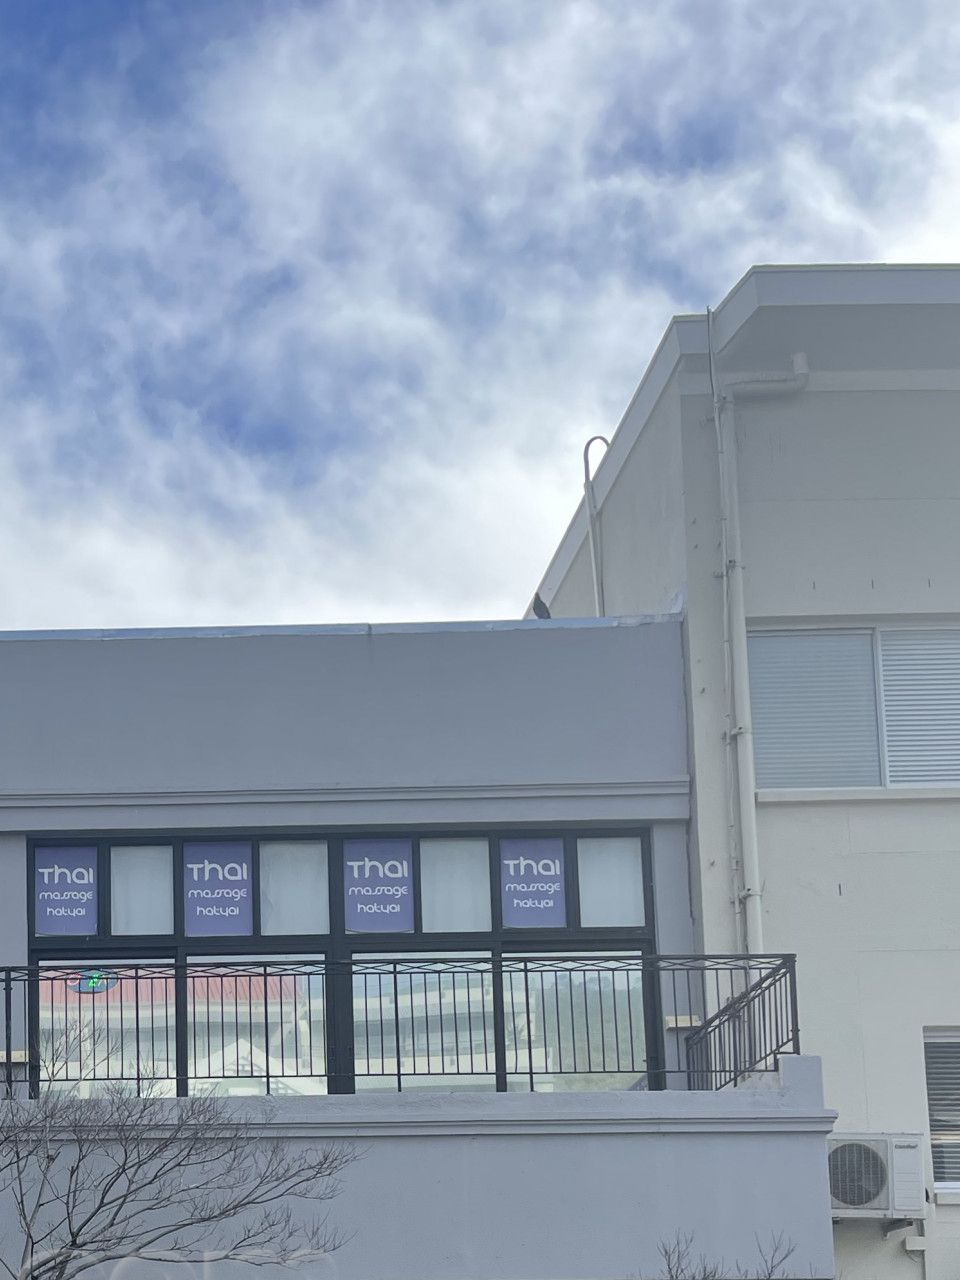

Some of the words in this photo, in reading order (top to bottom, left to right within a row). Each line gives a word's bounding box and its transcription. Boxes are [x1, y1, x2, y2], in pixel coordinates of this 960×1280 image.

[187, 859, 248, 882] Thai
[347, 857, 408, 879] Thai
[503, 856, 560, 876] Thai
[38, 864, 93, 885] Thai
[348, 886, 408, 898] massage
[506, 882, 560, 894] massage
[39, 890, 93, 903] massage
[188, 888, 248, 901] massage
[357, 902, 400, 914] hatyai
[513, 898, 554, 909] hatyai
[47, 906, 86, 917] hatyai
[196, 905, 239, 917] hatyai
